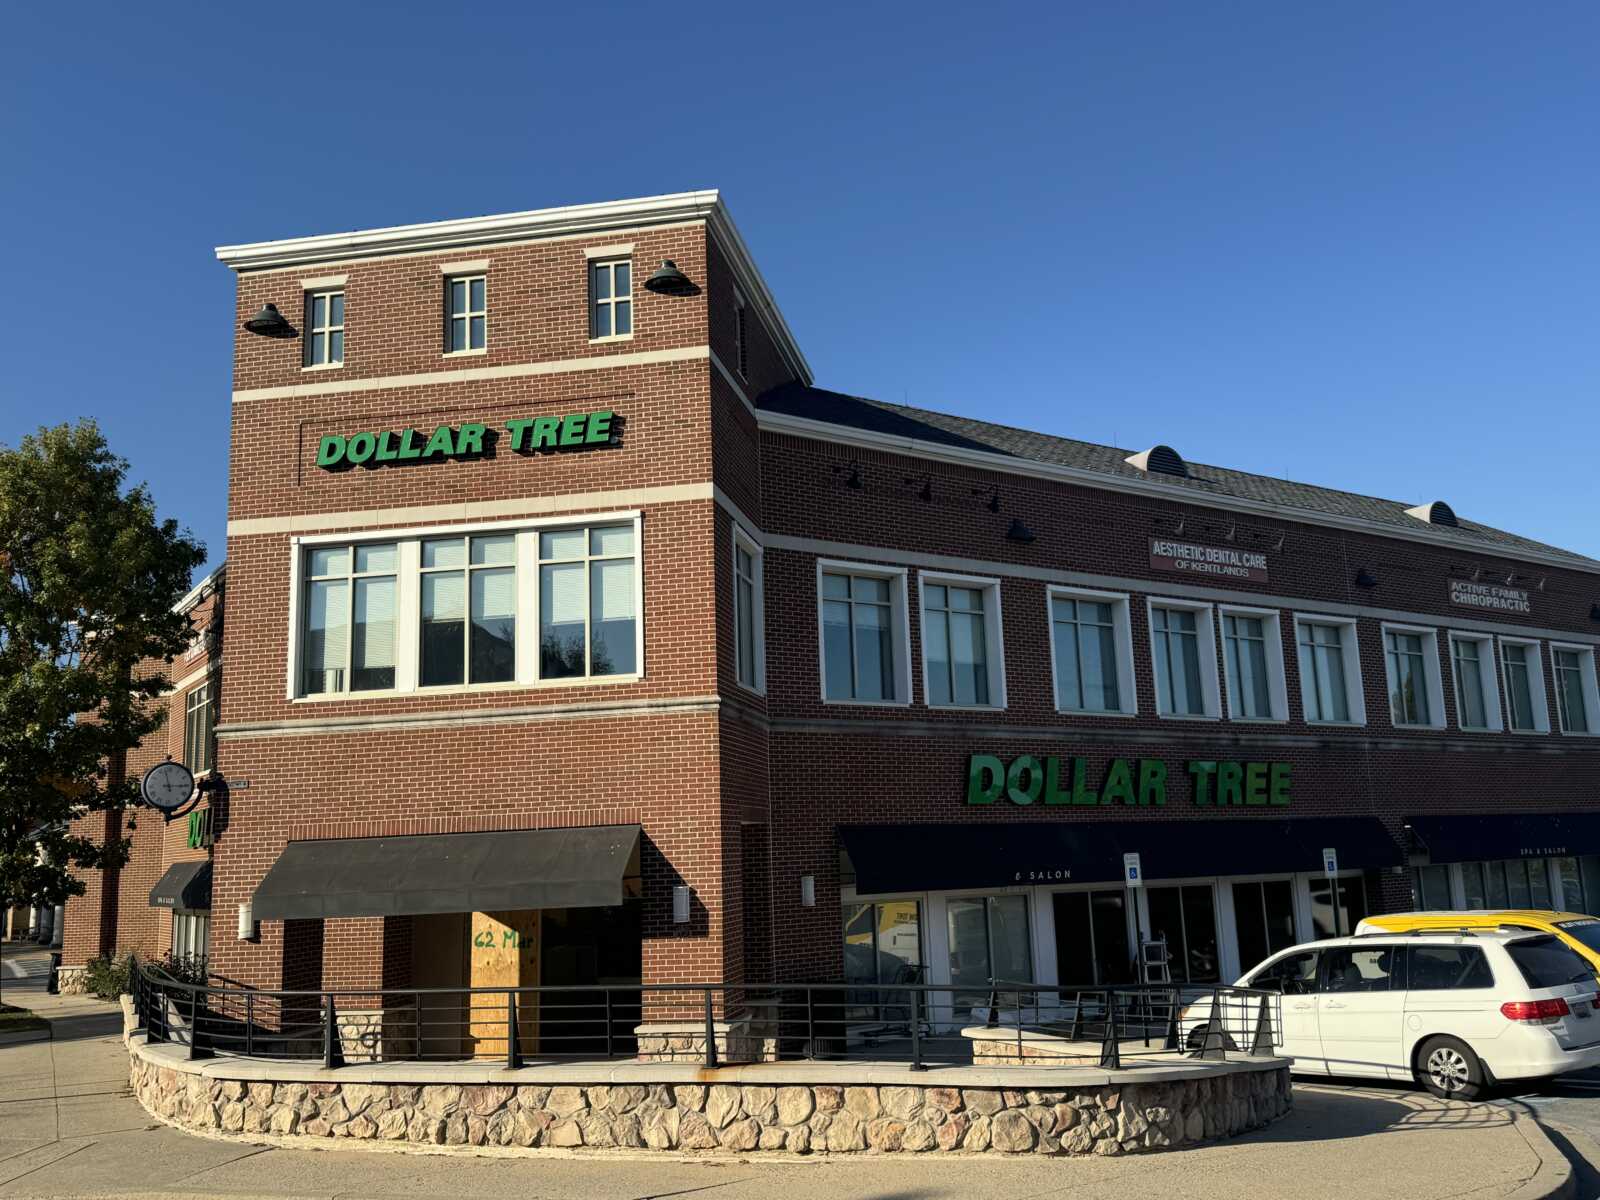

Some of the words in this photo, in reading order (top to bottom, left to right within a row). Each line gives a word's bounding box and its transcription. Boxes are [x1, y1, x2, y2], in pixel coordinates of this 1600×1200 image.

[317, 424, 487, 467] DOLLAR
[505, 410, 615, 451] TREE
[1152, 541, 1205, 561] AESTHETIC
[1205, 548, 1242, 566] DENTAL
[1243, 553, 1267, 569] CARE
[1175, 560, 1190, 569] OF
[1191, 561, 1249, 577] KENTLANDS
[1451, 582, 1489, 595] ACTIVE
[1451, 591, 1530, 612] CHIROPRACTIC
[967, 754, 1168, 806] DOLLAR
[1187, 760, 1293, 806] TREE
[1030, 869, 1071, 880] SALON
[474, 931, 496, 948] 62
